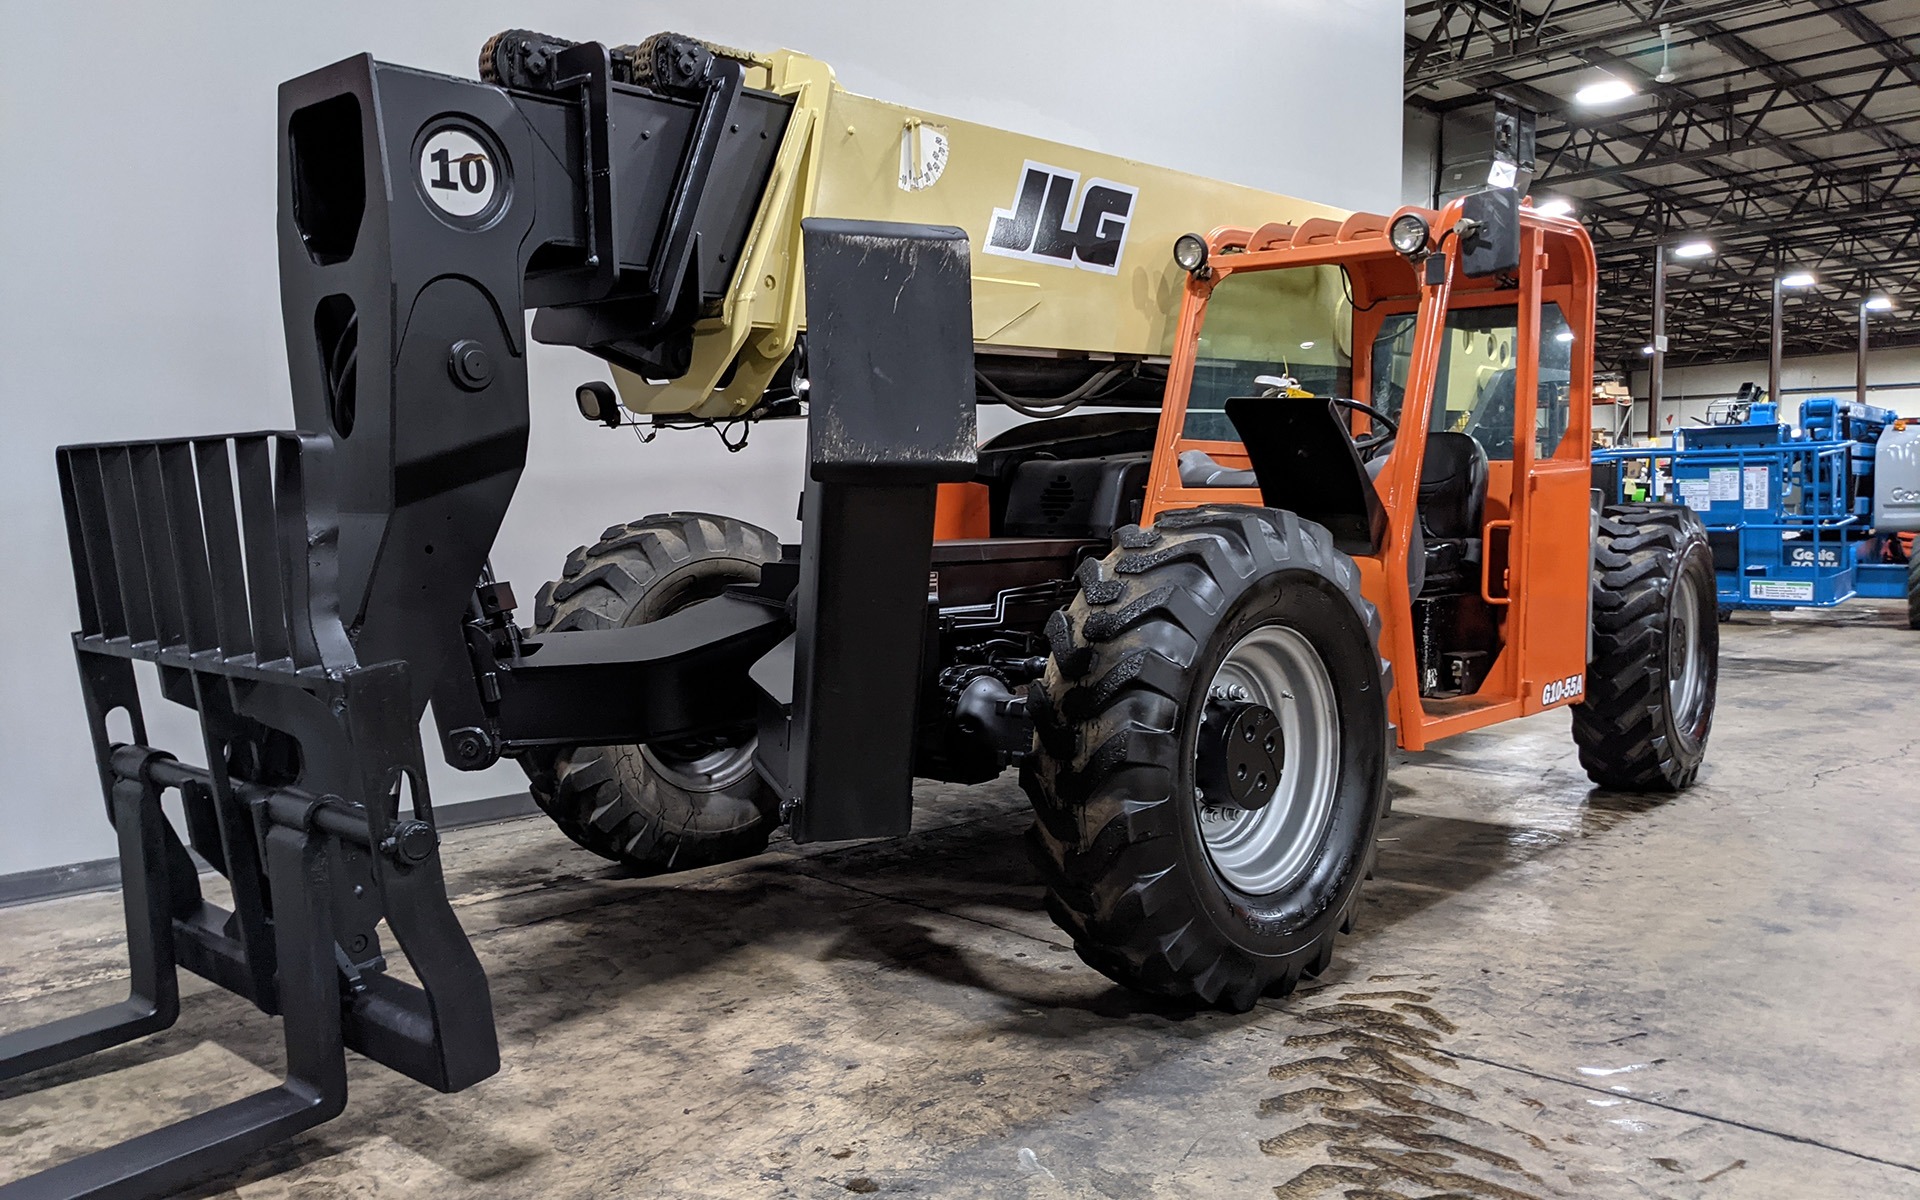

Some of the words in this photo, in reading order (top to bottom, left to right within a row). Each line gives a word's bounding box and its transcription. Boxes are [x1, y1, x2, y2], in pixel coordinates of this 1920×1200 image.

[430, 148, 487, 194] 10
[985, 165, 1137, 272] JLG
[1541, 673, 1583, 706] G10-55A
